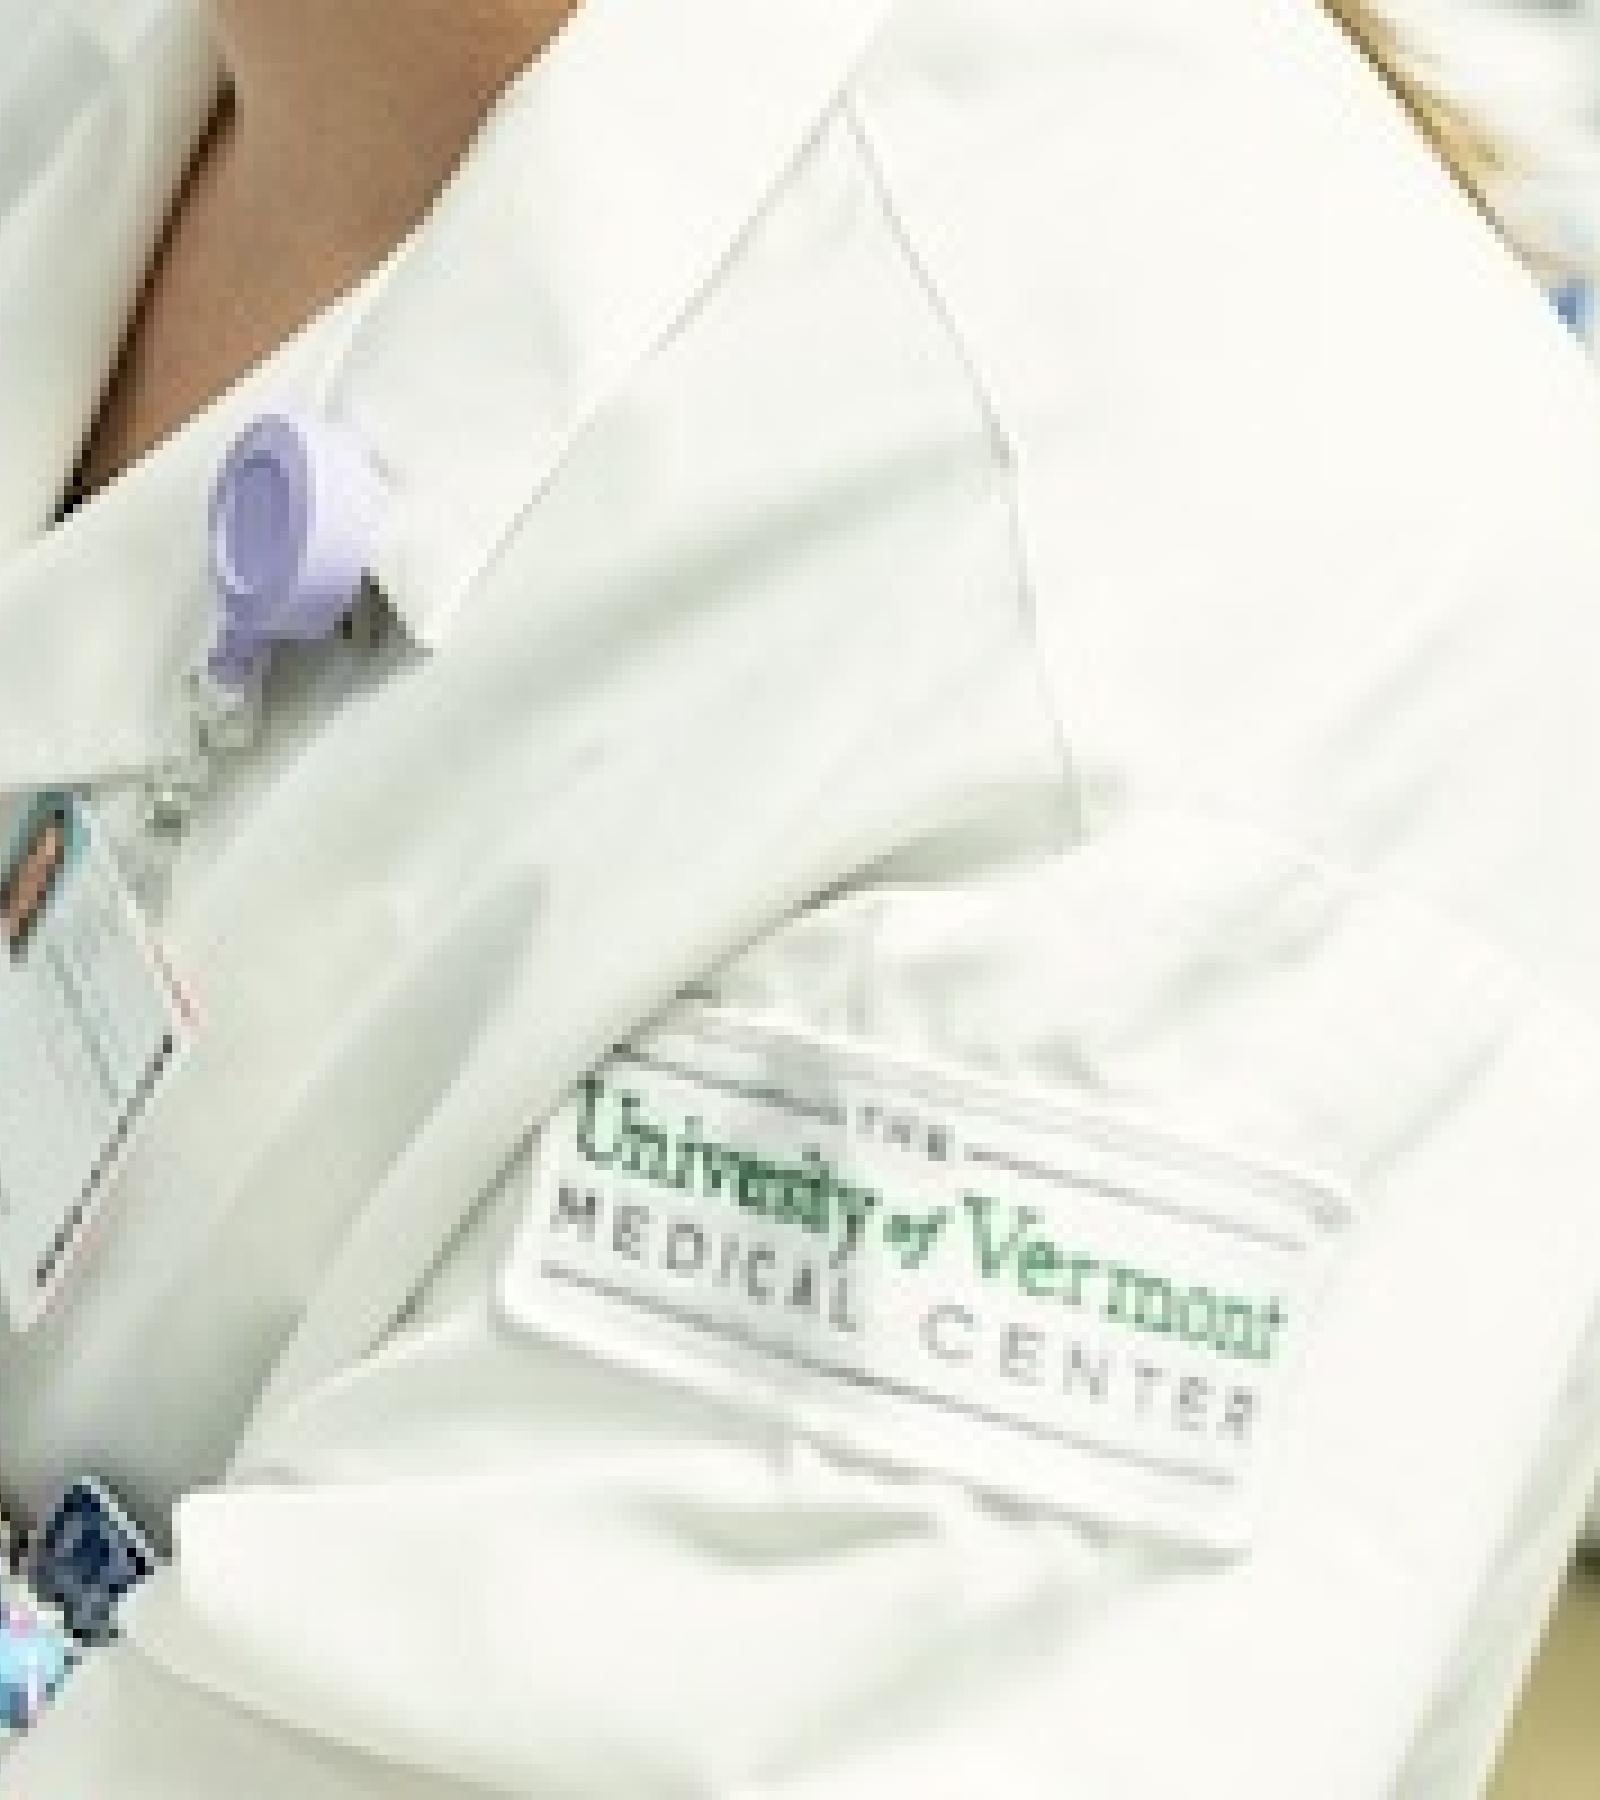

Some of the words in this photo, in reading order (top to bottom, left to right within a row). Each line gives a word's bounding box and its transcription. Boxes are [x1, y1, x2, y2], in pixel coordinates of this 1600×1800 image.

[549, 1186, 858, 1332] MEDICAL
[919, 1304, 1256, 1440] CENTER
[571, 1072, 878, 1268] University
[883, 1204, 947, 1268] of
[964, 1192, 1289, 1364] Vermont
